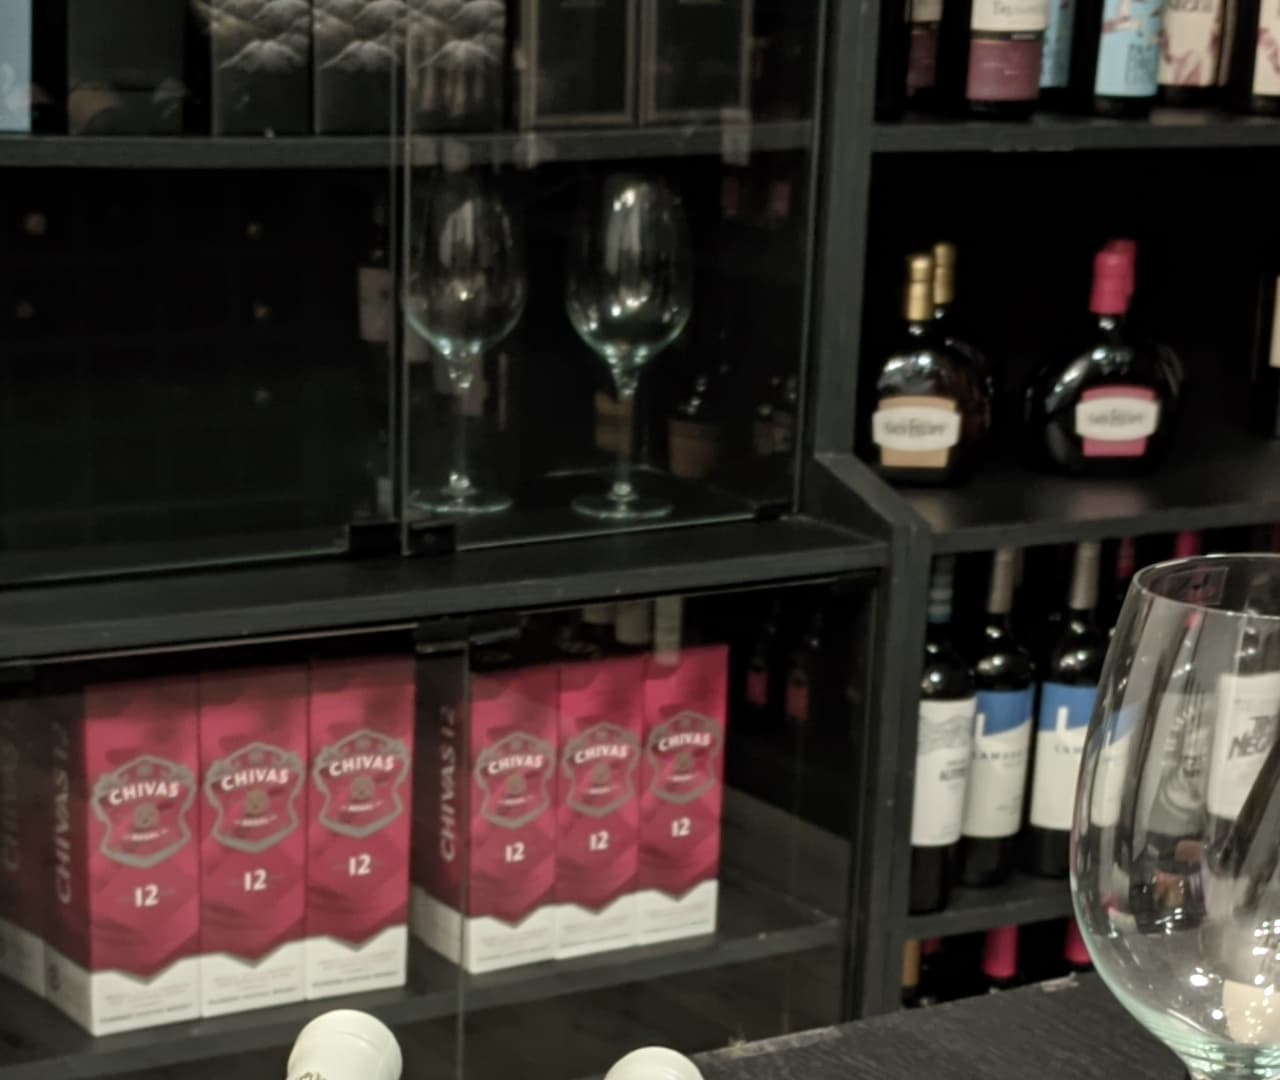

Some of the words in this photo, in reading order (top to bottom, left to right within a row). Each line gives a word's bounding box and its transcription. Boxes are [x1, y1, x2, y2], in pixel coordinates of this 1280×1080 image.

[658, 733, 711, 751] CHIVAS
[487, 754, 544, 775] CHIVAS
[574, 744, 628, 765] CHIVAS
[329, 755, 396, 777] CHIVAS
[221, 768, 290, 791] CHIVAS
[109, 781, 180, 806] CHIVAS
[440, 746, 456, 862] CHIVAS
[54, 768, 71, 904] CHIVAS
[672, 818, 691, 837] 12
[589, 831, 610, 850] 12
[505, 843, 526, 863] 12
[348, 854, 372, 877] 12
[243, 869, 268, 892] 12
[134, 884, 160, 908] 12
